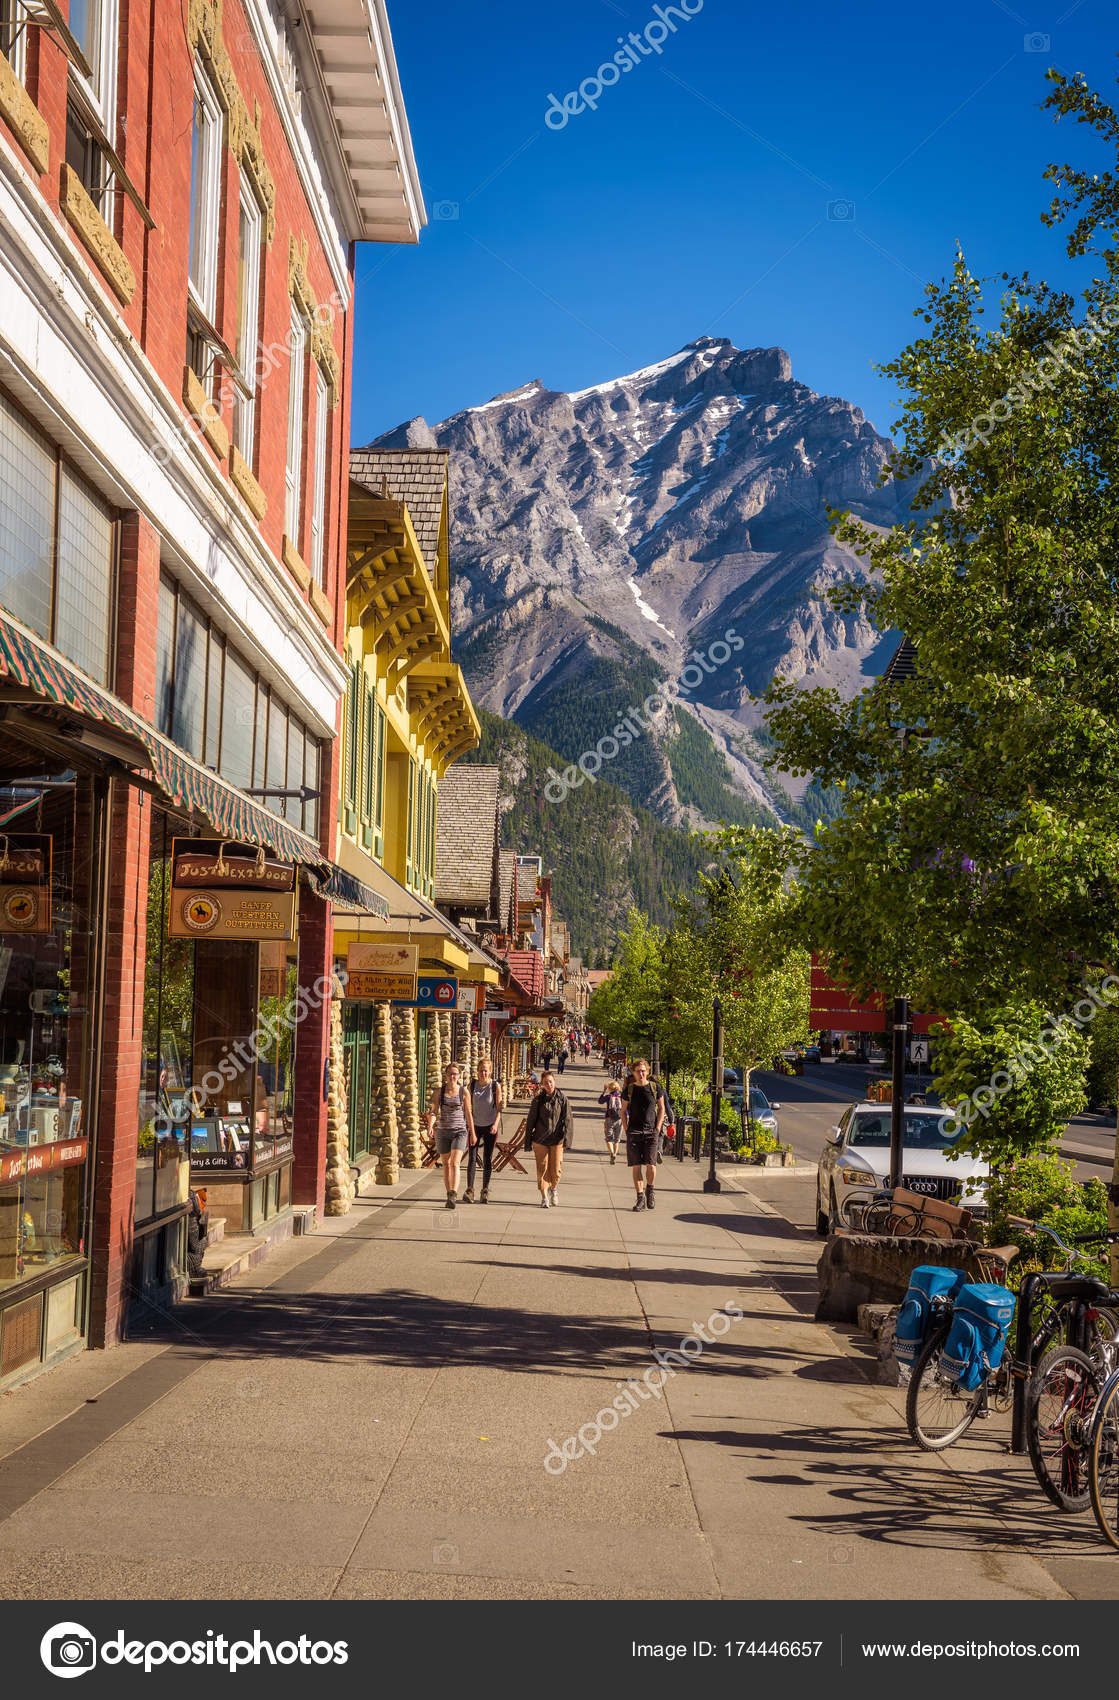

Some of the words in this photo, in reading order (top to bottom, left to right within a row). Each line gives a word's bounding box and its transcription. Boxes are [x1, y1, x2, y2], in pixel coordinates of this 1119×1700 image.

[240, 901, 272, 910] BANFF
[231, 910, 280, 920] WESTERN
[224, 919, 285, 931] OUTFITTERS
[212, 1158, 228, 1166] Gifts
